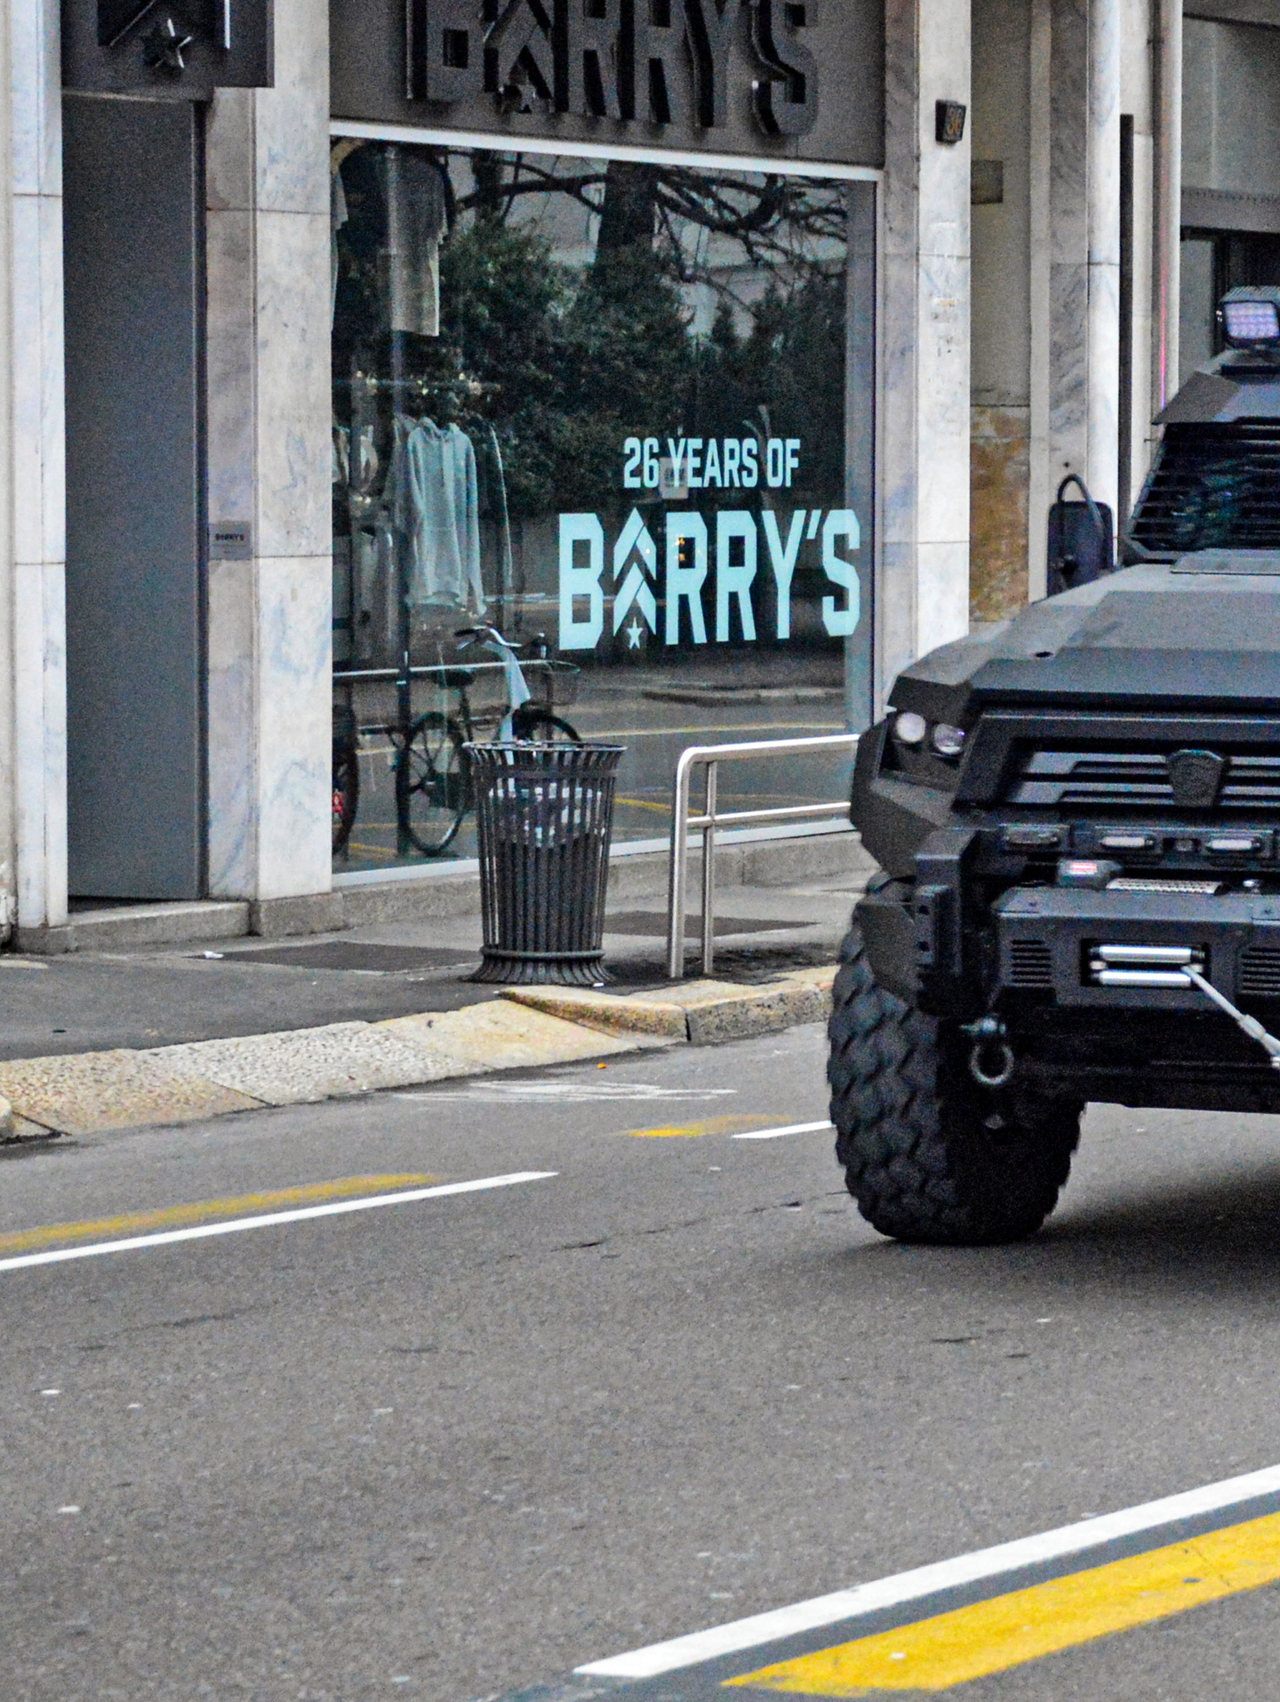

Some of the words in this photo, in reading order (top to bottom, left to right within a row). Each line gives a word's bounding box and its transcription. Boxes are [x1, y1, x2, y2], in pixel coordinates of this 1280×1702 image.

[622, 436, 660, 488] 26
[667, 437, 758, 488] YEARS
[766, 438, 801, 488] OF
[558, 507, 861, 651] BARRY'S
